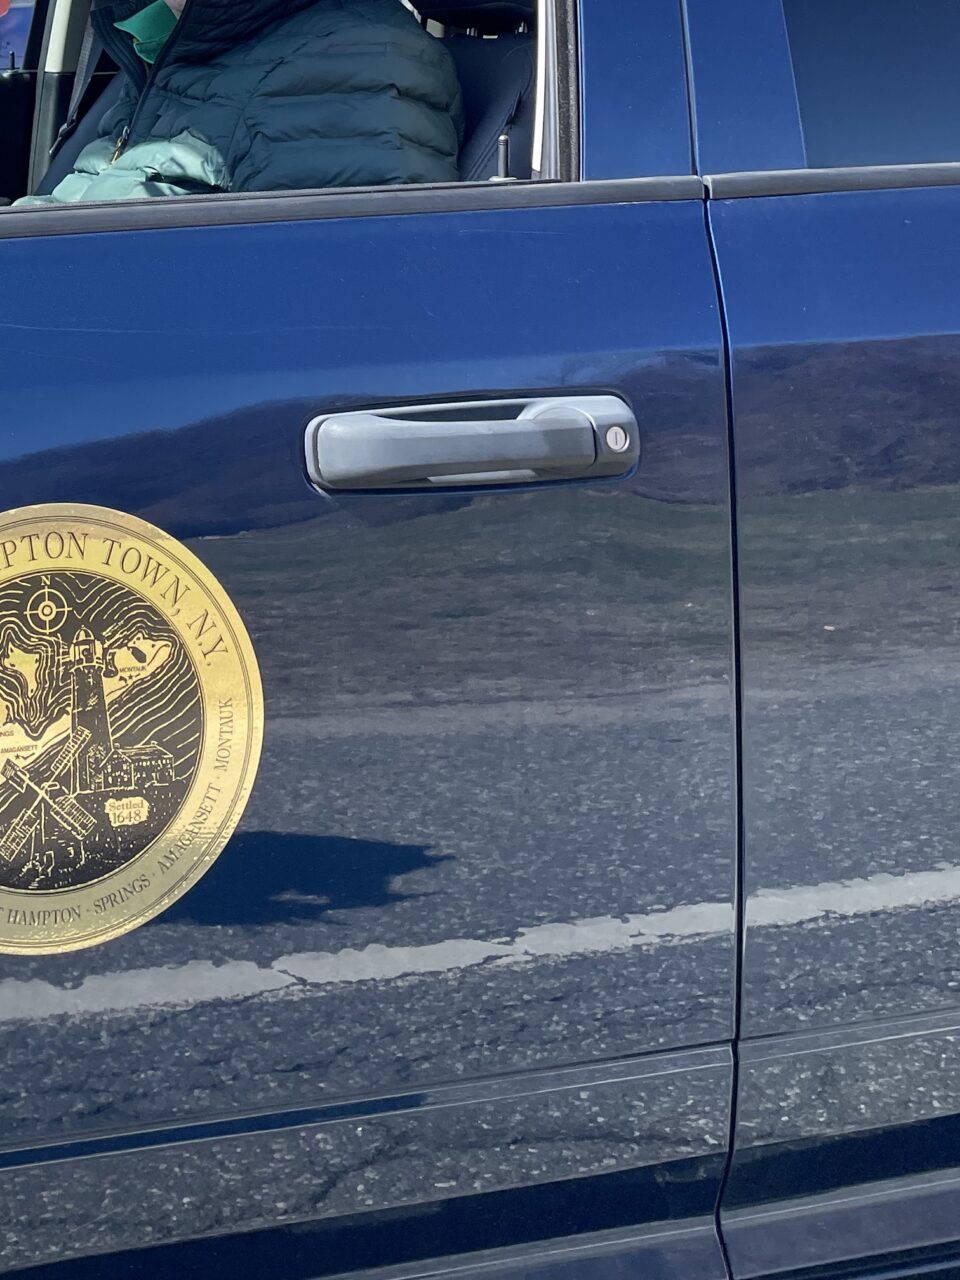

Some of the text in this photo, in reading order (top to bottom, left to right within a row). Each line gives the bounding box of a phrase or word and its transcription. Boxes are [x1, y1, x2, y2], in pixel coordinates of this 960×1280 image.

[40, 575, 51, 586] N
[215, 697, 233, 772] MONTAUK
[108, 799, 145, 811] Settled
[110, 810, 142, 825] 1648
[157, 783, 220, 875] AMAGANSETT
[93, 873, 151, 915] SPRINGS
[7, 905, 81, 925] HAMPTON
